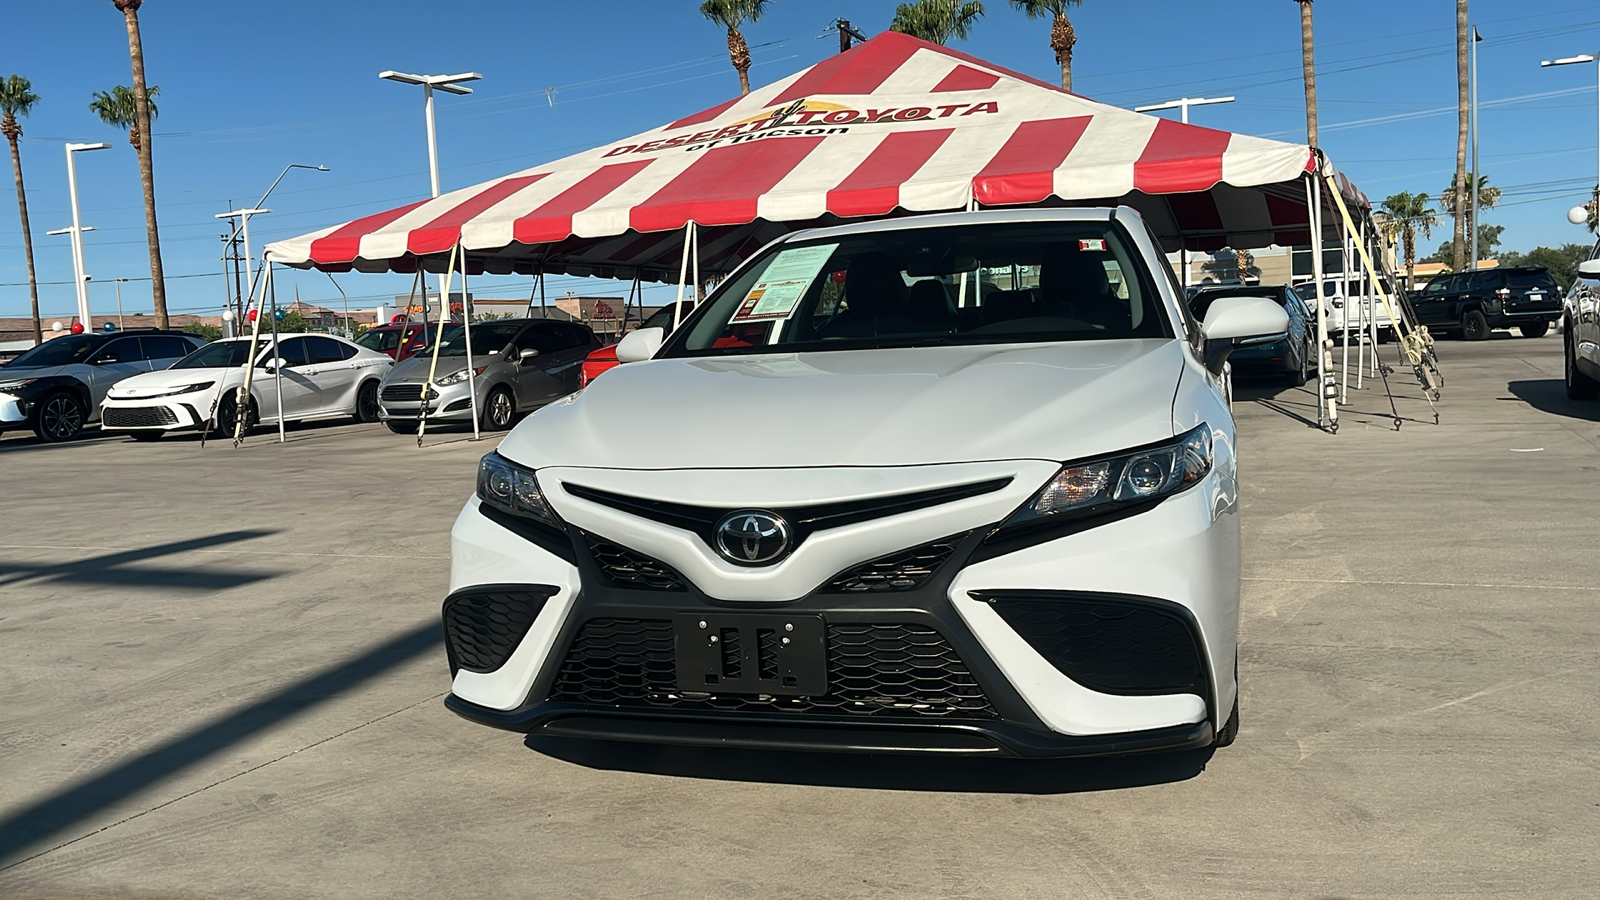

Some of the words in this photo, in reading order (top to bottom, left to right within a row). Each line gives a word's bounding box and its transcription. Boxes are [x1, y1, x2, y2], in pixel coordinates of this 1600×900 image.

[601, 115, 781, 158] DESERT
[793, 101, 999, 124] TOYOTA
[685, 138, 722, 152] of
[729, 127, 849, 144] Tucson
